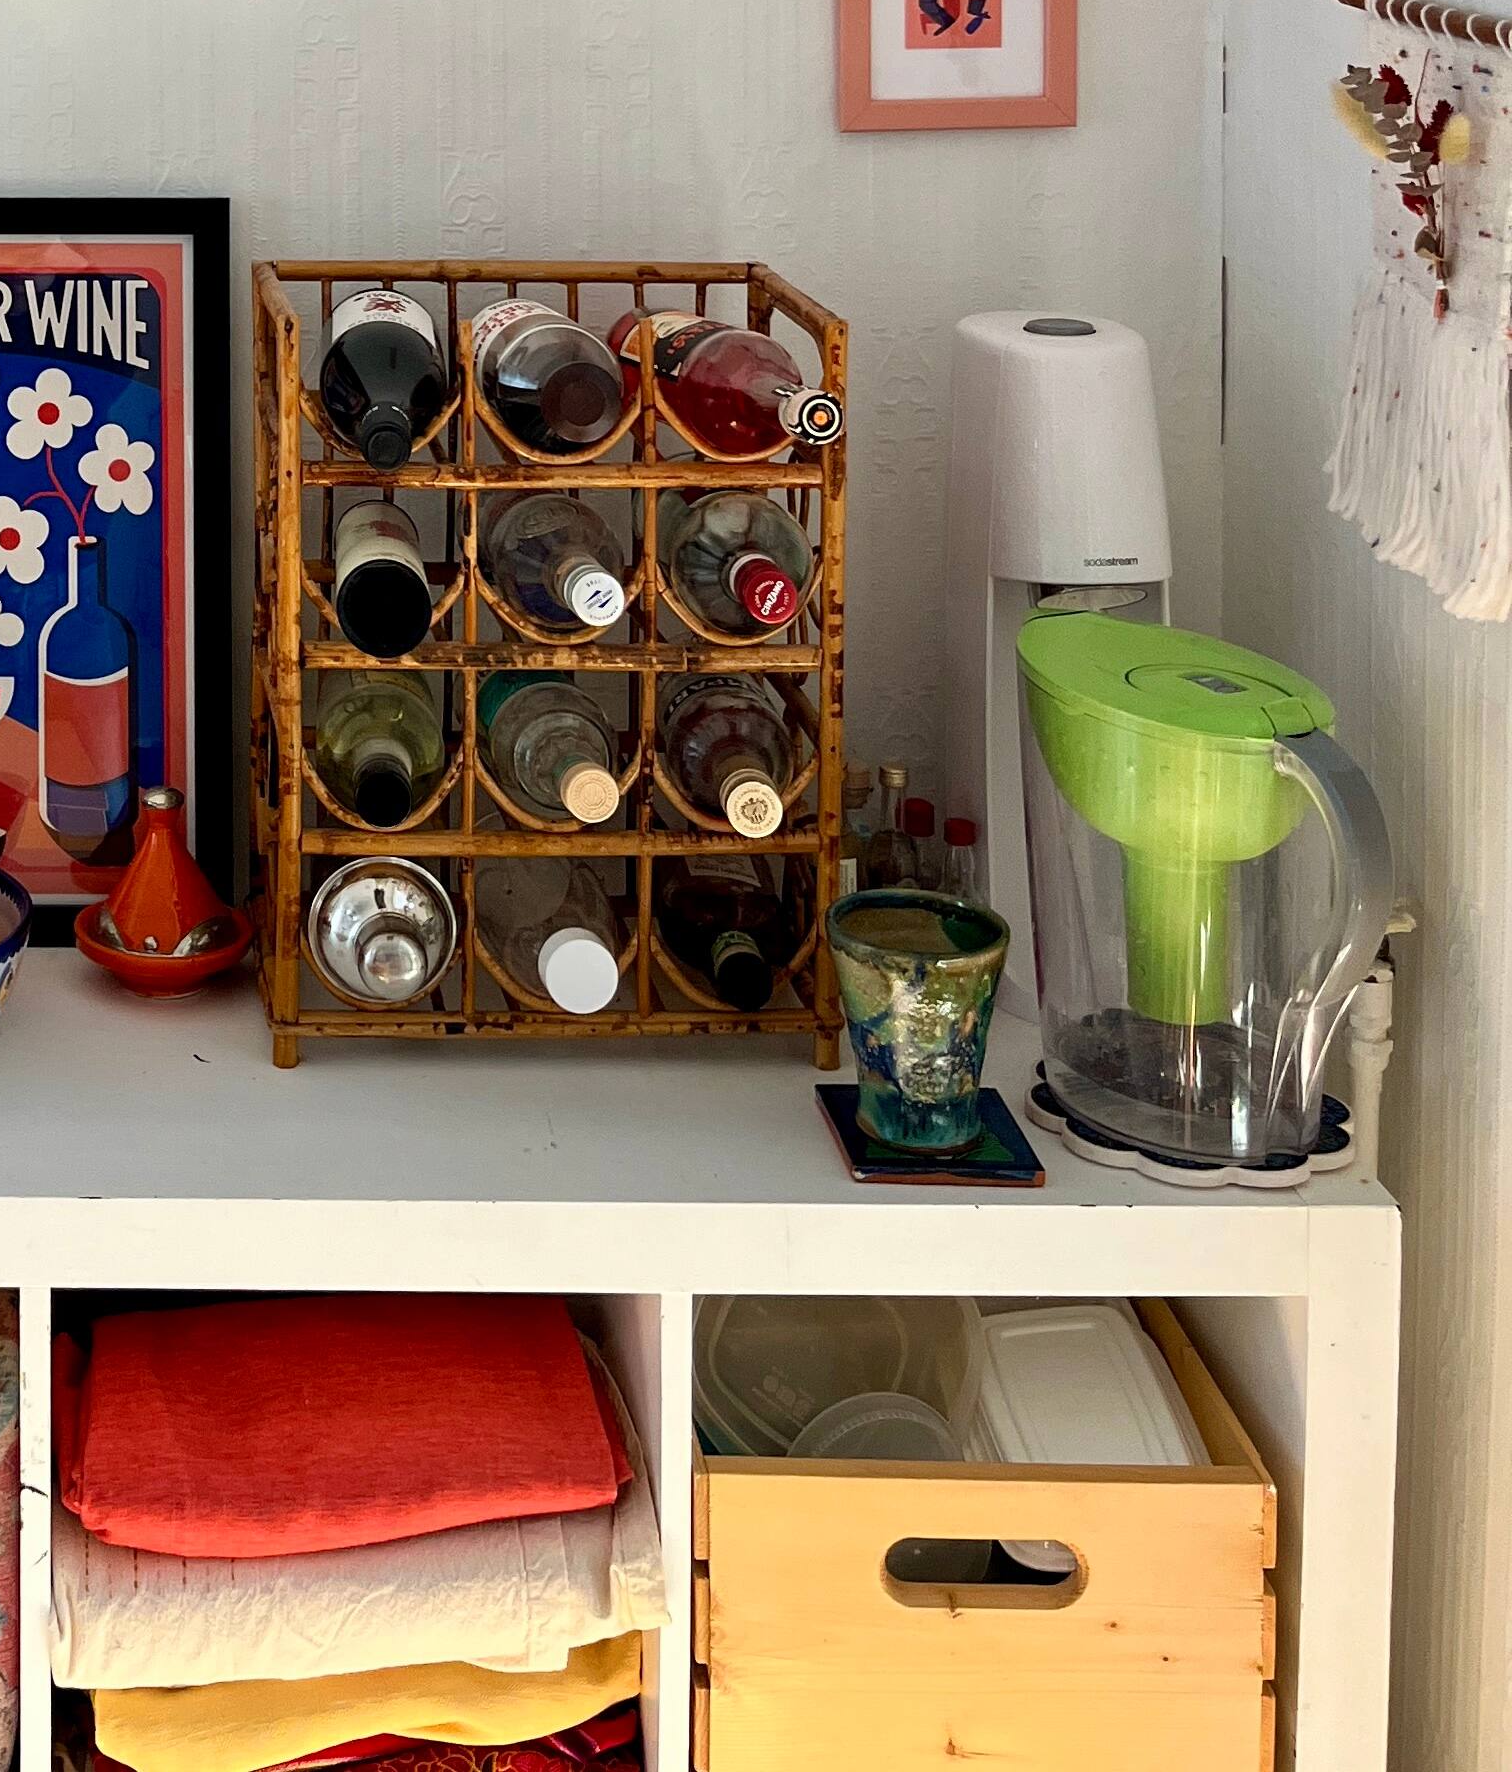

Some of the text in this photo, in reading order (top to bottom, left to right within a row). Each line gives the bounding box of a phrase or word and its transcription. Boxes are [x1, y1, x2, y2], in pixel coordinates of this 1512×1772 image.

[25, 280, 150, 370] WINE
[1084, 557, 1139, 567] sodastream
[761, 581, 785, 616] CINZANO
